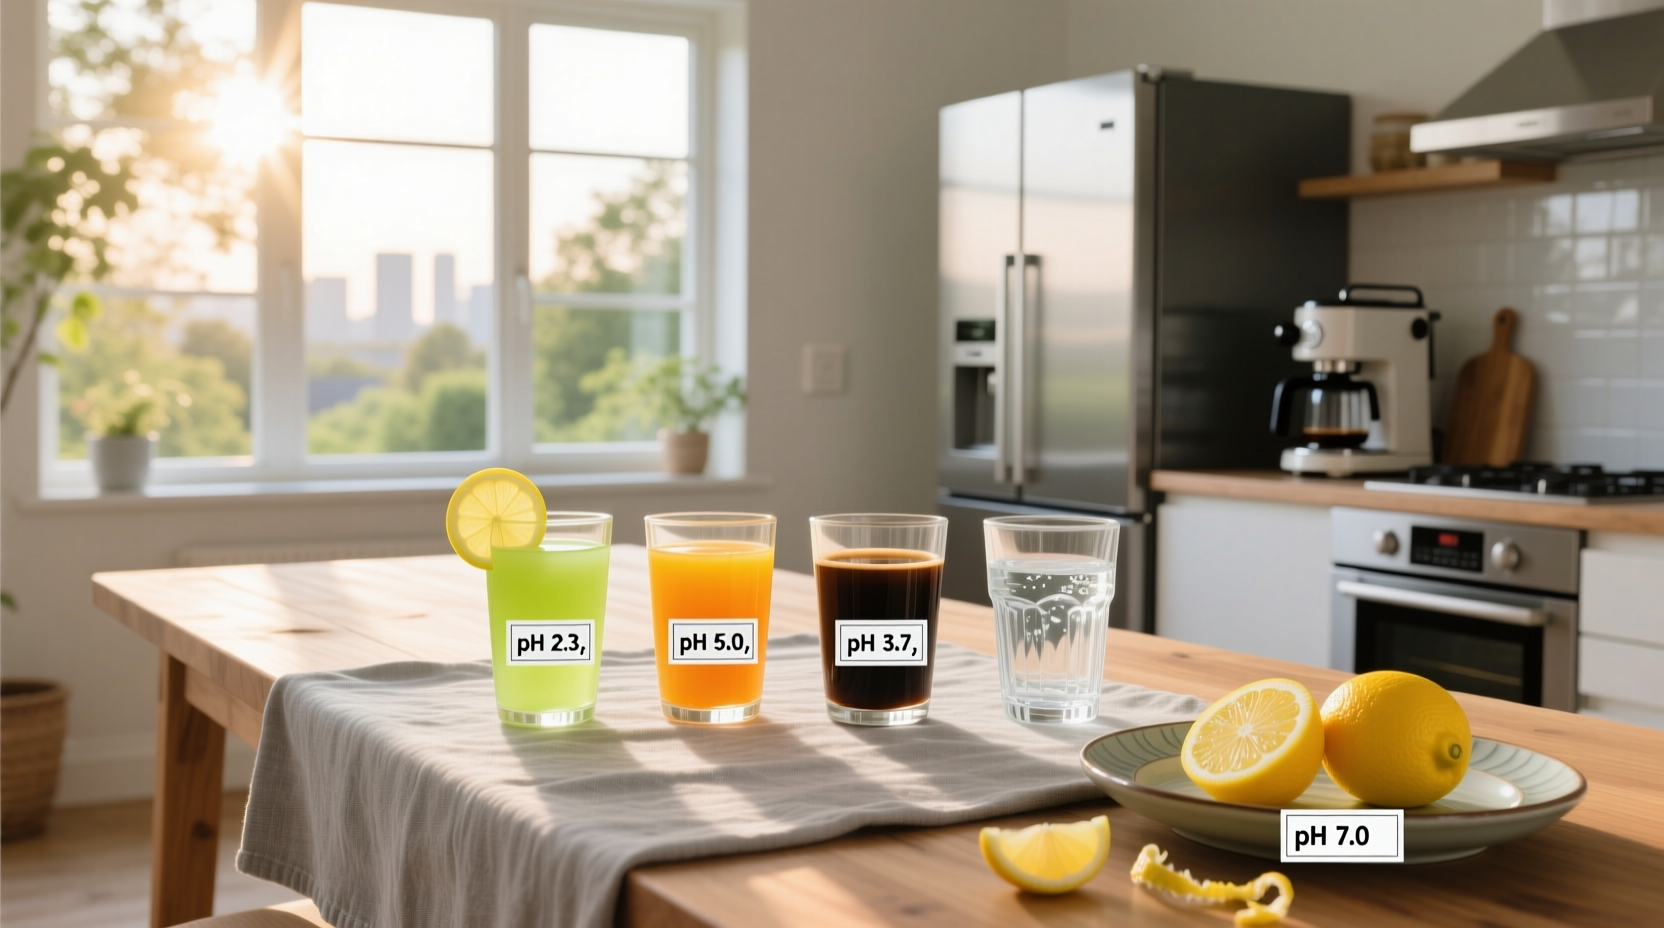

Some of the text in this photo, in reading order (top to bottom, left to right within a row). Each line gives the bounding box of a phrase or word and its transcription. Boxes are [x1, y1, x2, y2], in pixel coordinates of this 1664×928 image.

[517, 633, 586, 656] pH 2.3,
[680, 632, 750, 656] pH 5.0,
[847, 633, 918, 657] pH 3.7,
[1295, 825, 1370, 852] pH 7.0
